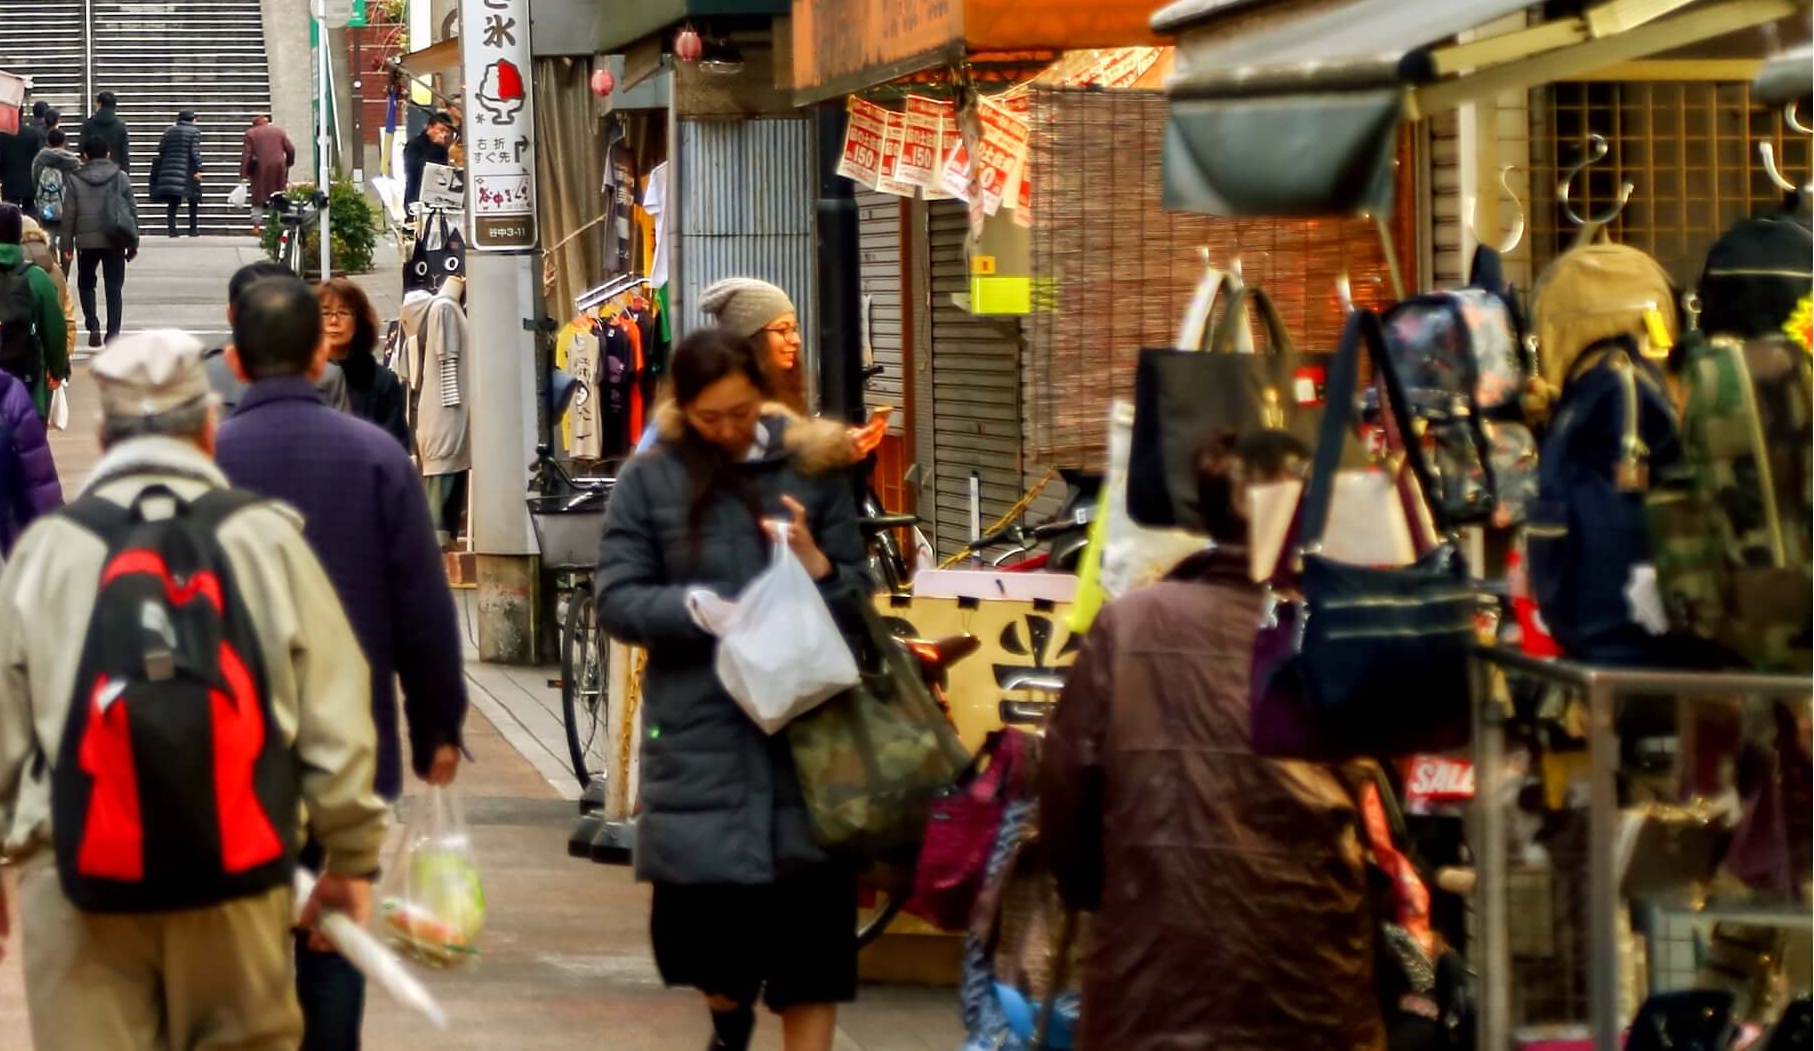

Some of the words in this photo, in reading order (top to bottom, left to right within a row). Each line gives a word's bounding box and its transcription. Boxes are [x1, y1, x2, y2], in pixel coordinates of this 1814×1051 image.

[477, 138, 505, 151] 右折
[474, 151, 511, 164] すぐ先
[489, 227, 526, 239] 谷中3-11
